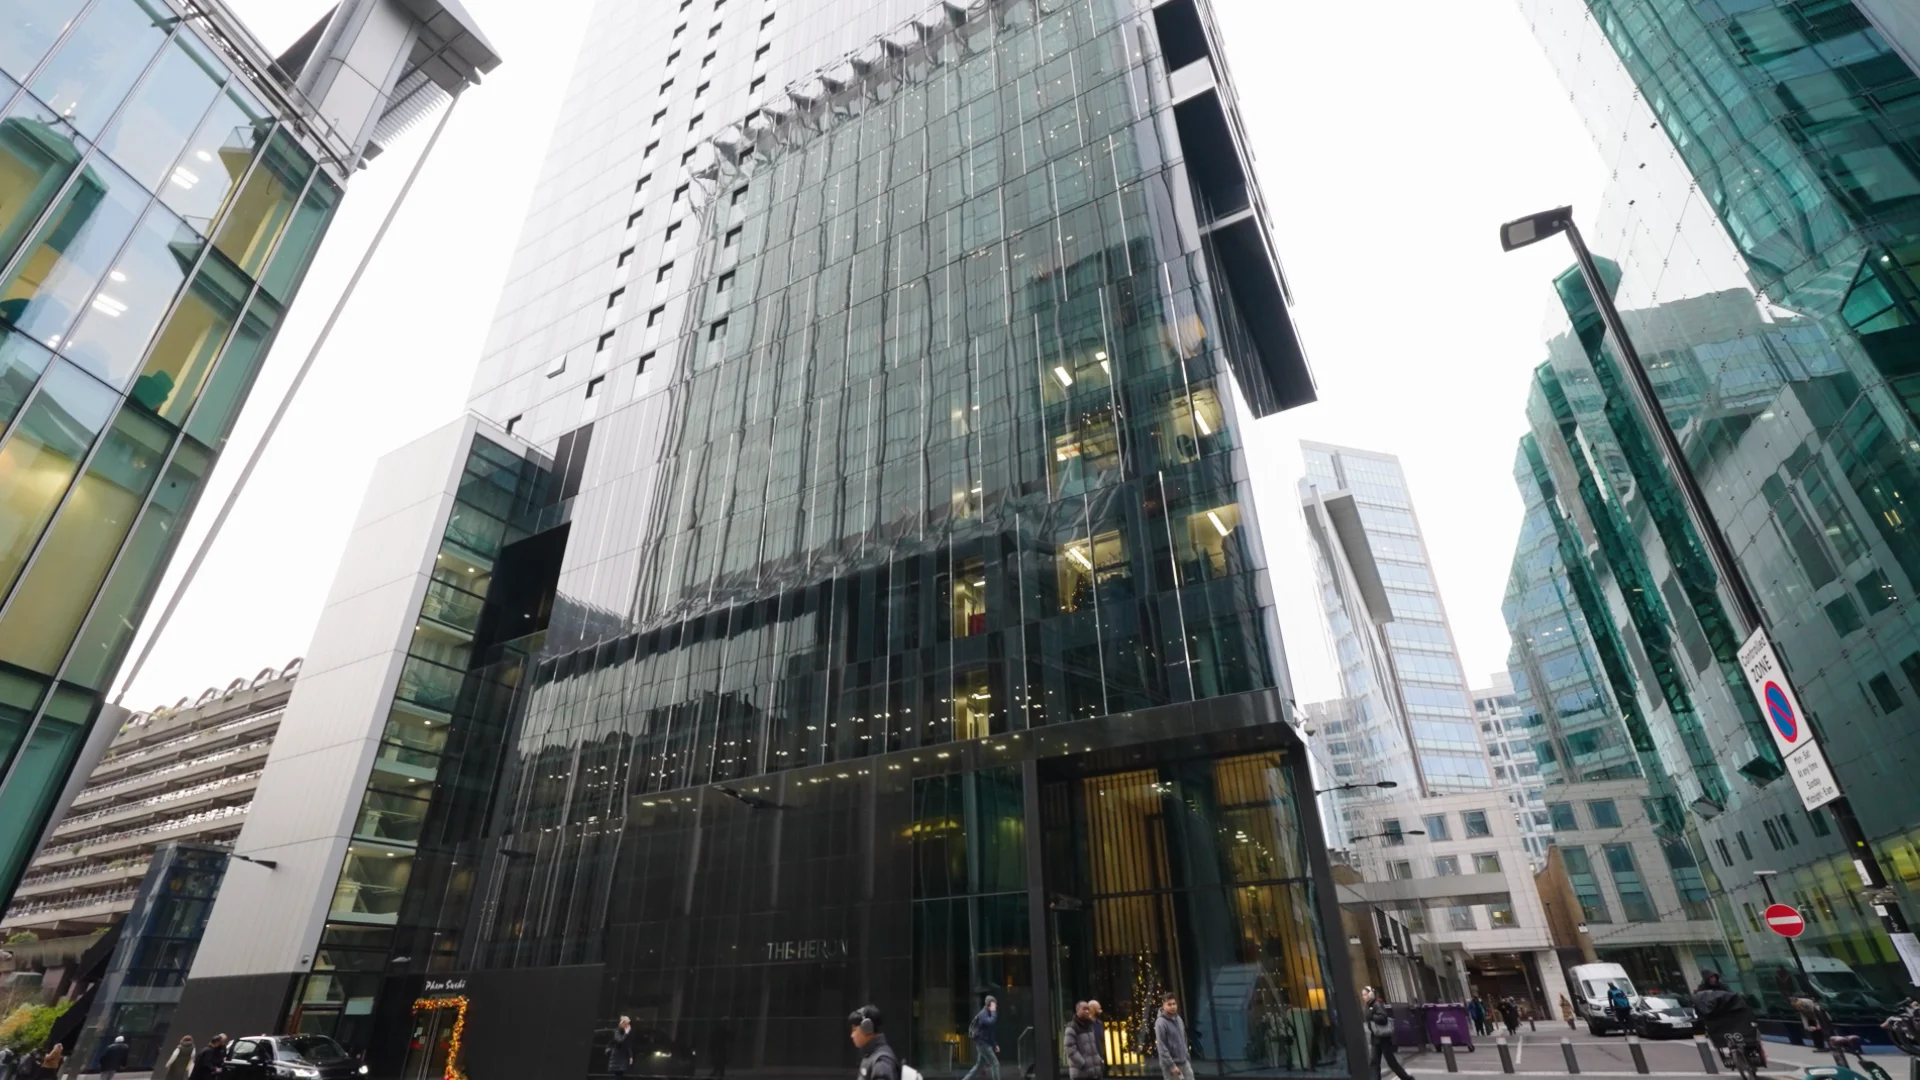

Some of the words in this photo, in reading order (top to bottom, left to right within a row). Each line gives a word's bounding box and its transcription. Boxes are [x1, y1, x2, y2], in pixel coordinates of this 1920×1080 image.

[1751, 655, 1772, 683] ZONE
[767, 941, 794, 960] THE
[797, 939, 848, 959] HERON
[446, 979, 466, 989] Sushi
